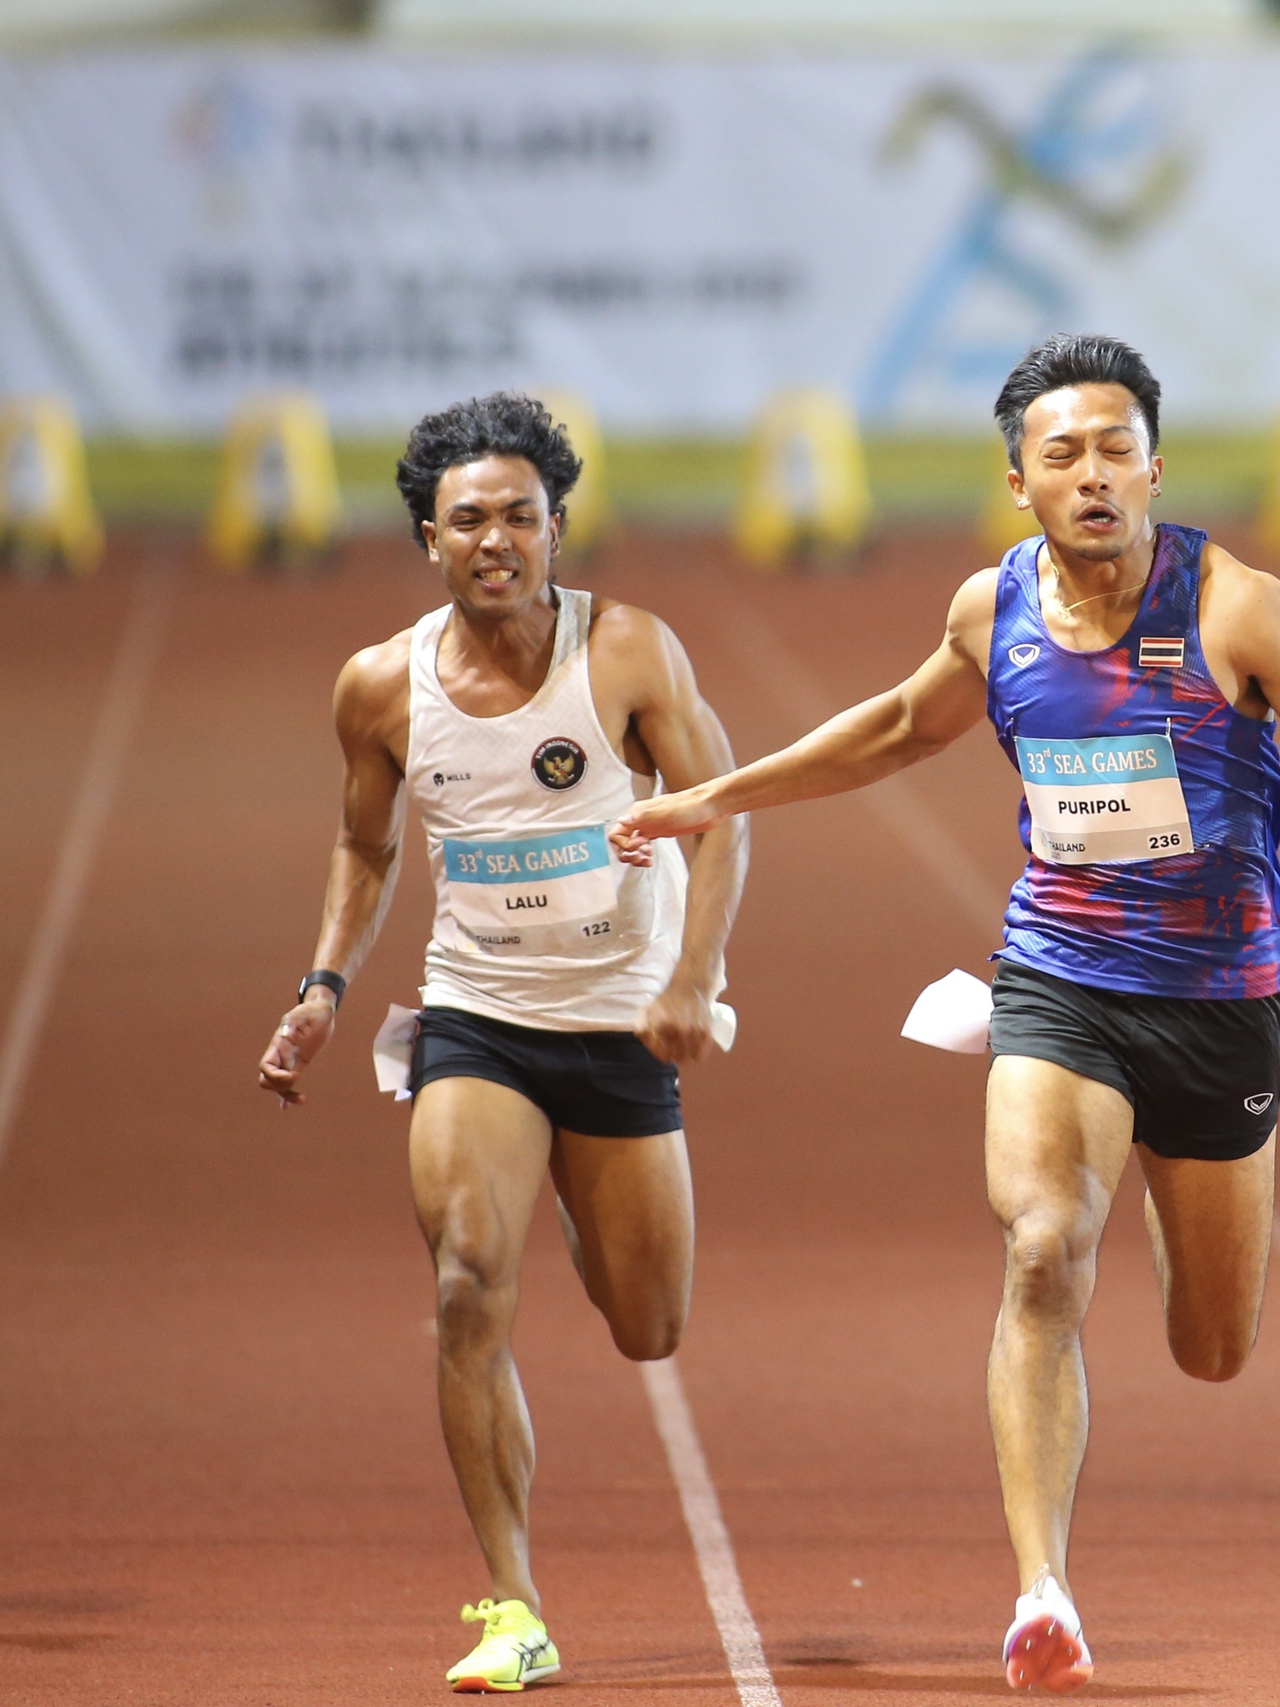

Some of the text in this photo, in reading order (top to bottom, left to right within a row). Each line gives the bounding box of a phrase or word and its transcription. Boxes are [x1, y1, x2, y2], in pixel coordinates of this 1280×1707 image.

[1026, 747, 1158, 775] 33rd SEA GAMES
[1058, 799, 1131, 815] PURIPOL
[1149, 833, 1181, 850] 236
[457, 841, 590, 874] 33rd SEA GAMES
[505, 895, 548, 910] LALU
[582, 921, 611, 937] 122
[477, 935, 521, 945] THAILAND
